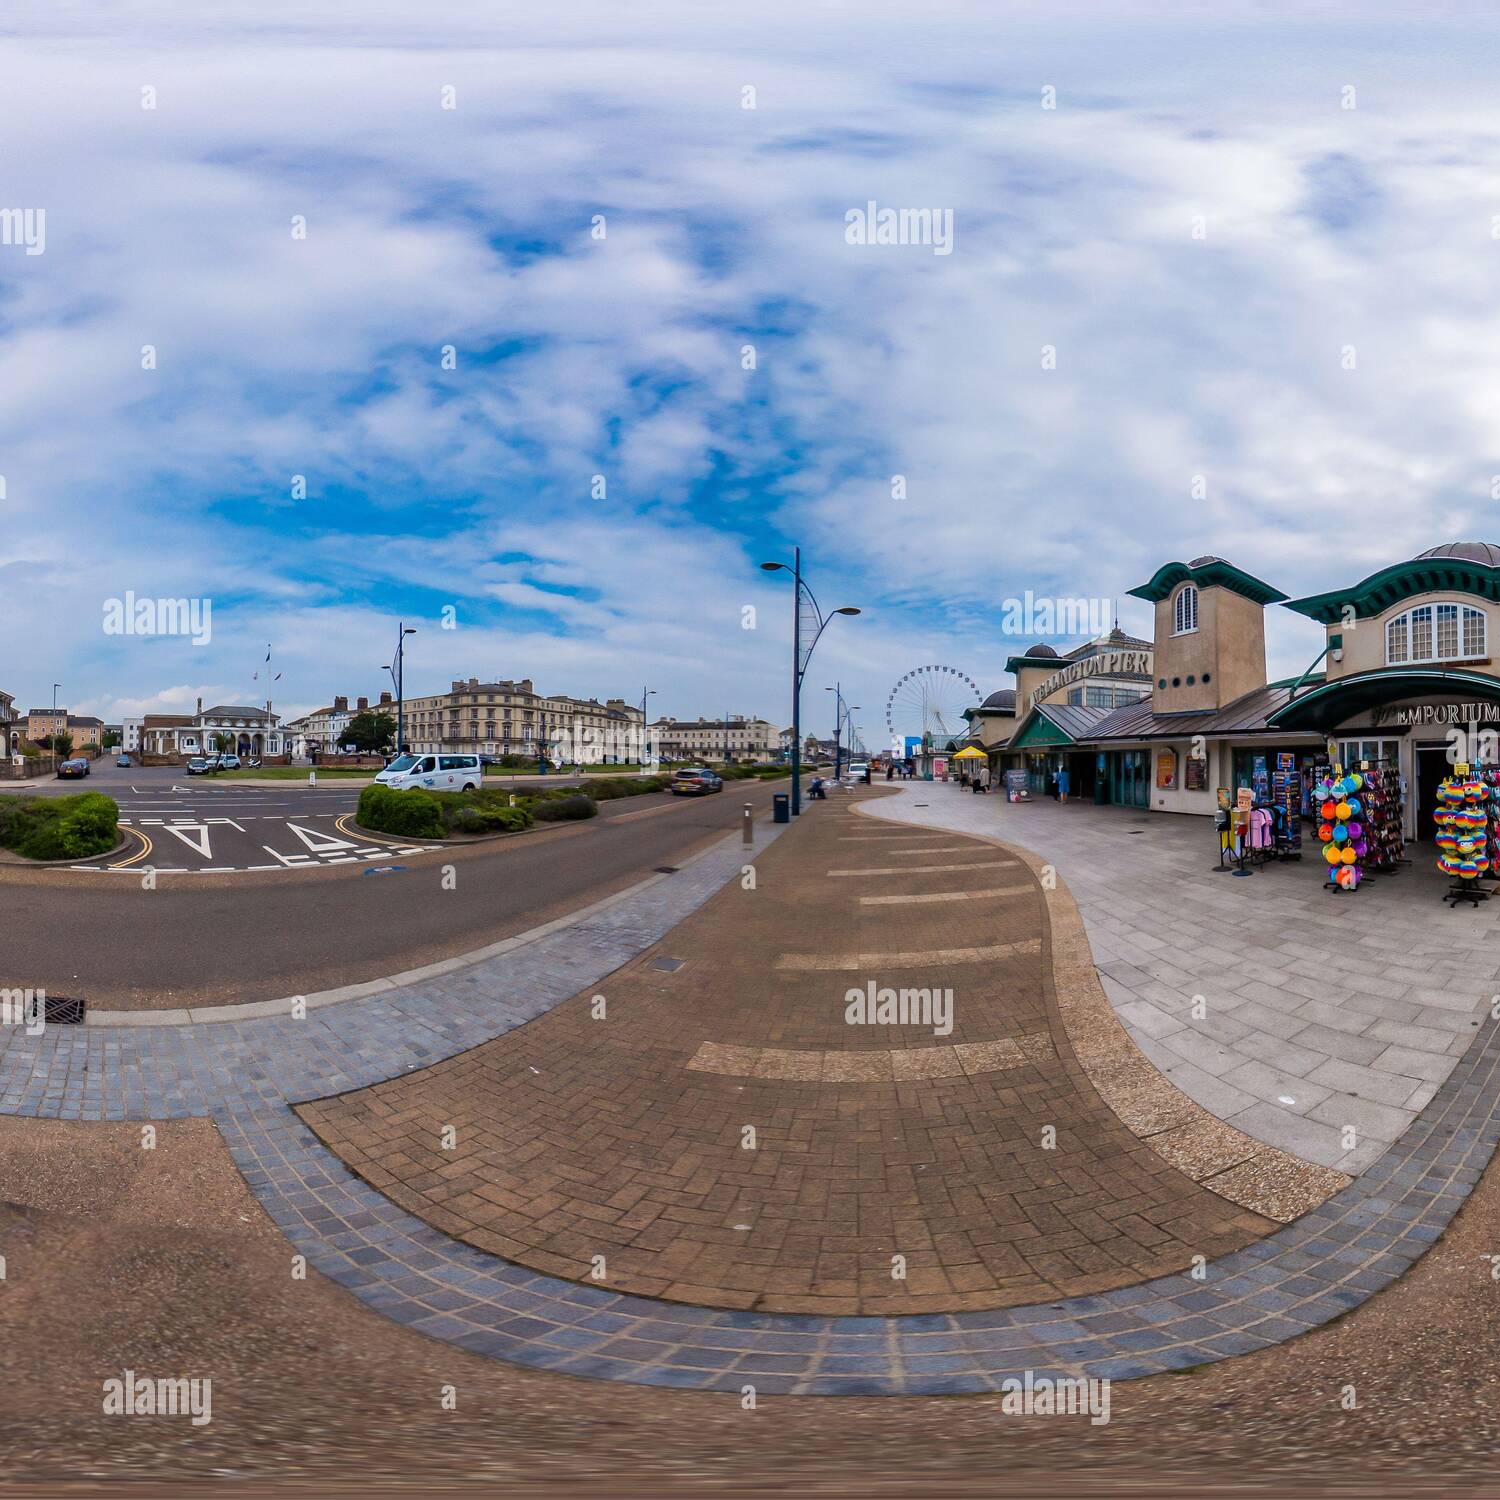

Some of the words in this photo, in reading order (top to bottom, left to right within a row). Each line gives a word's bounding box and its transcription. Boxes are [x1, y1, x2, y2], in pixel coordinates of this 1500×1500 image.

[1032, 656, 1105, 703] WELLINGTON
[1109, 652, 1148, 674] PIER
[1397, 702, 1500, 725] EMPORIUM
